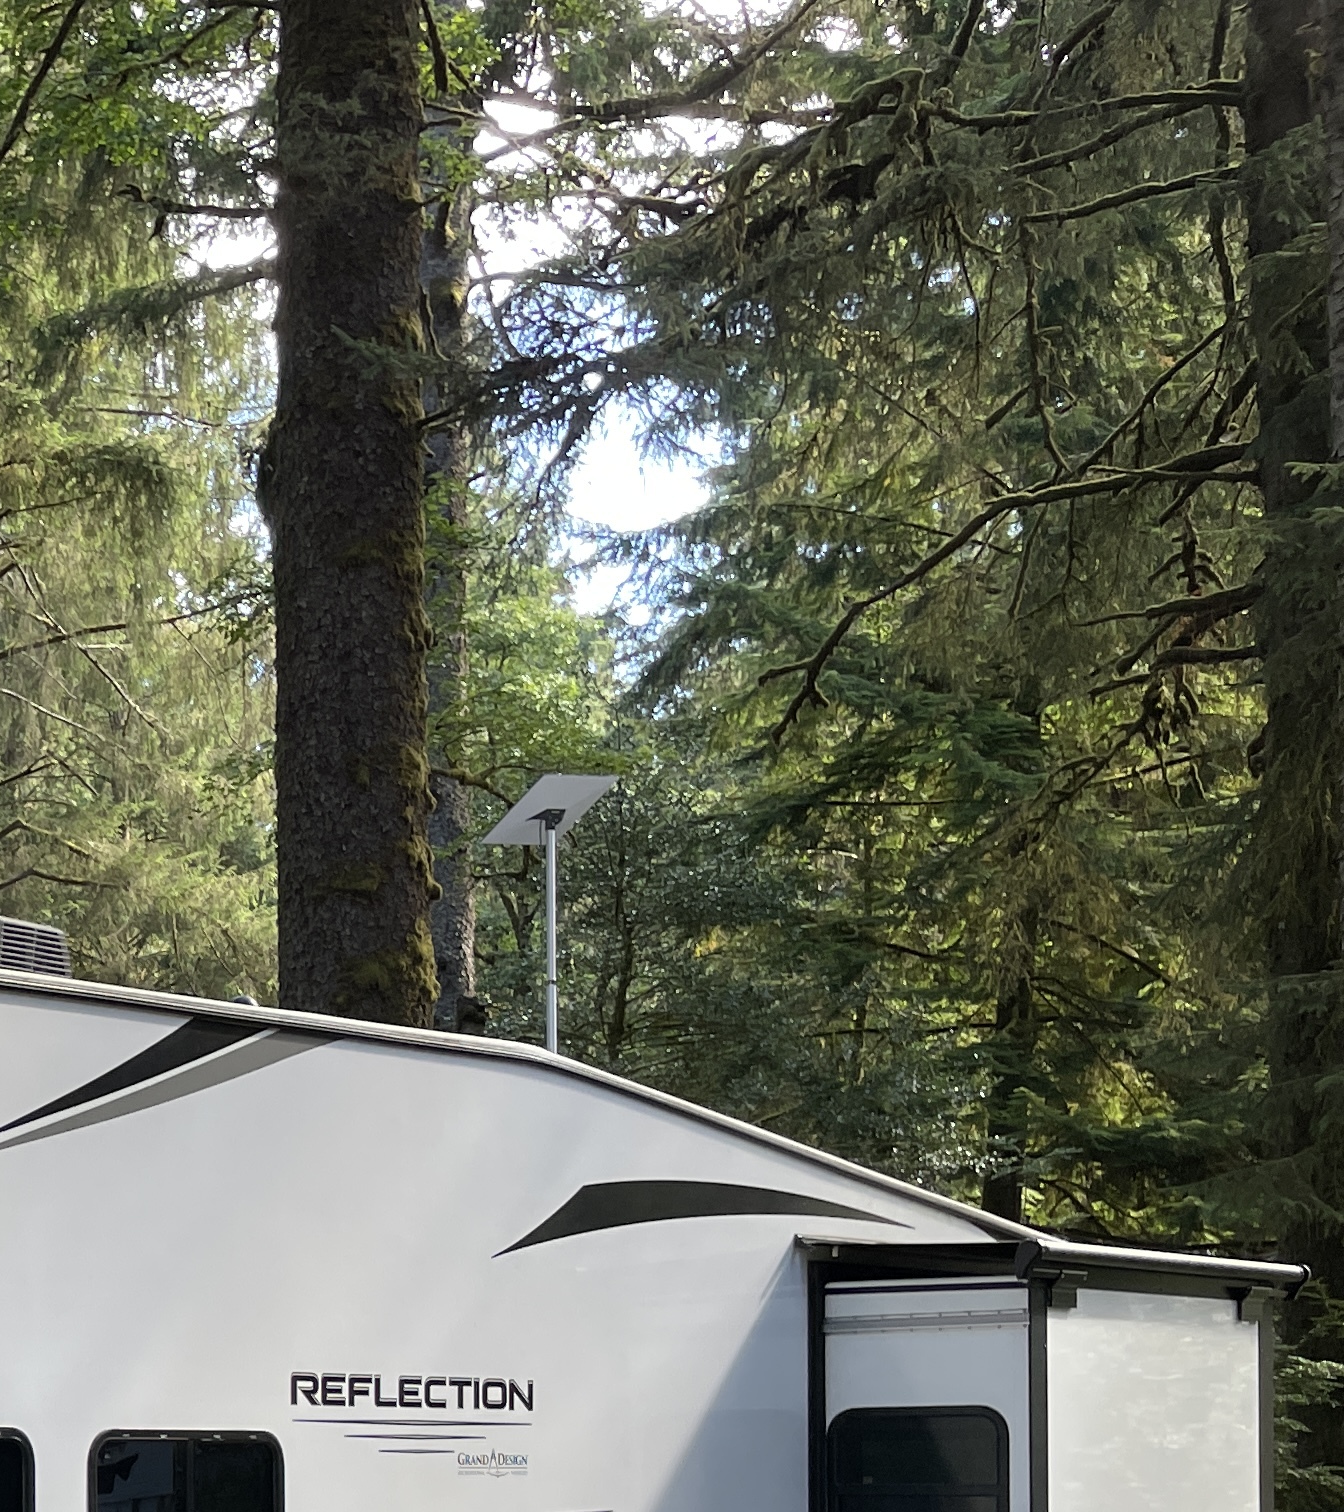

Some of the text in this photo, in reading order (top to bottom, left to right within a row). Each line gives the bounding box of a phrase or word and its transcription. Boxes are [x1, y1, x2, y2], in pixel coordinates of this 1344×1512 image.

[291, 1371, 534, 1411] REFLECTION
[457, 1452, 528, 1466] GRAND DESIGN
